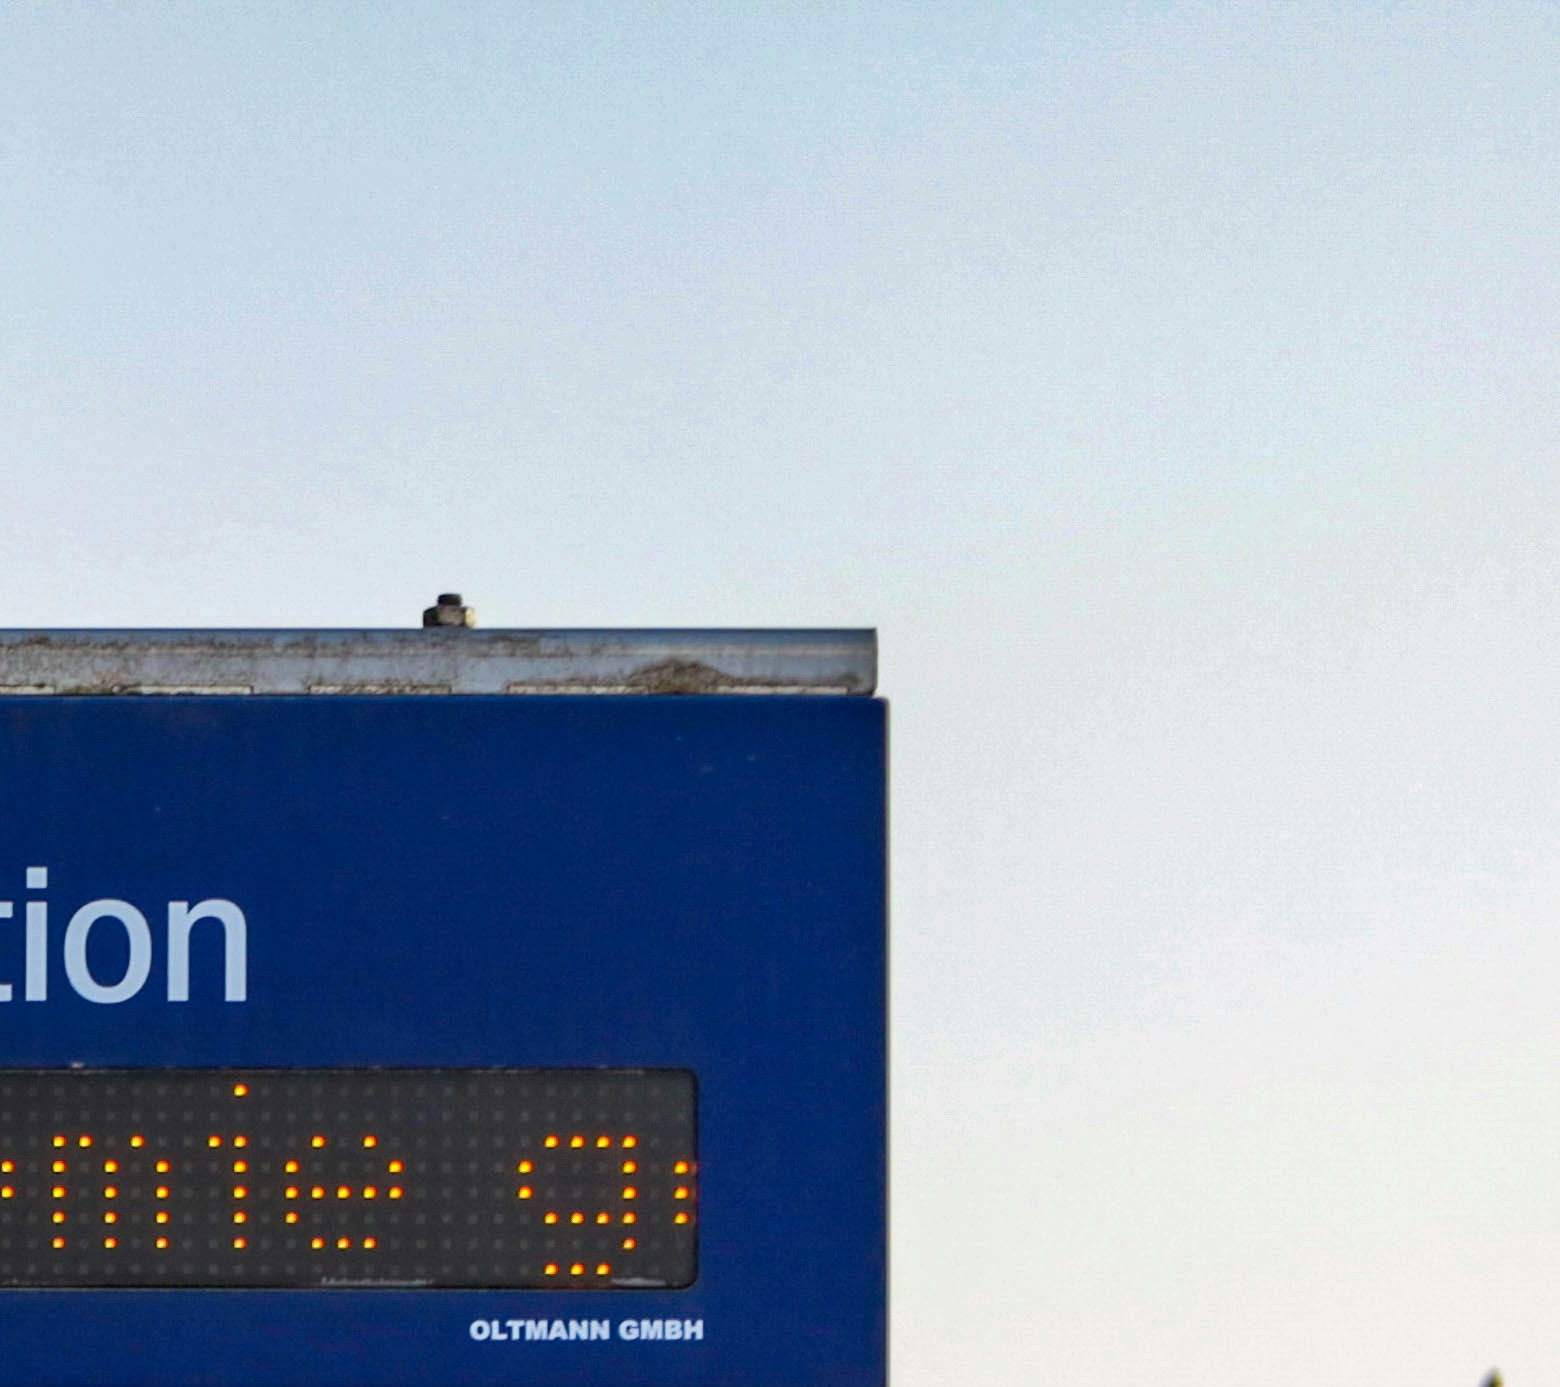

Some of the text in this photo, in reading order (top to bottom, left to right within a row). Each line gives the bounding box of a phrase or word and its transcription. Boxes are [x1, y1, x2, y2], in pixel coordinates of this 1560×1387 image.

[516, 1134, 694, 1276] g
[468, 1318, 705, 1341] OLTMANN GMBH
